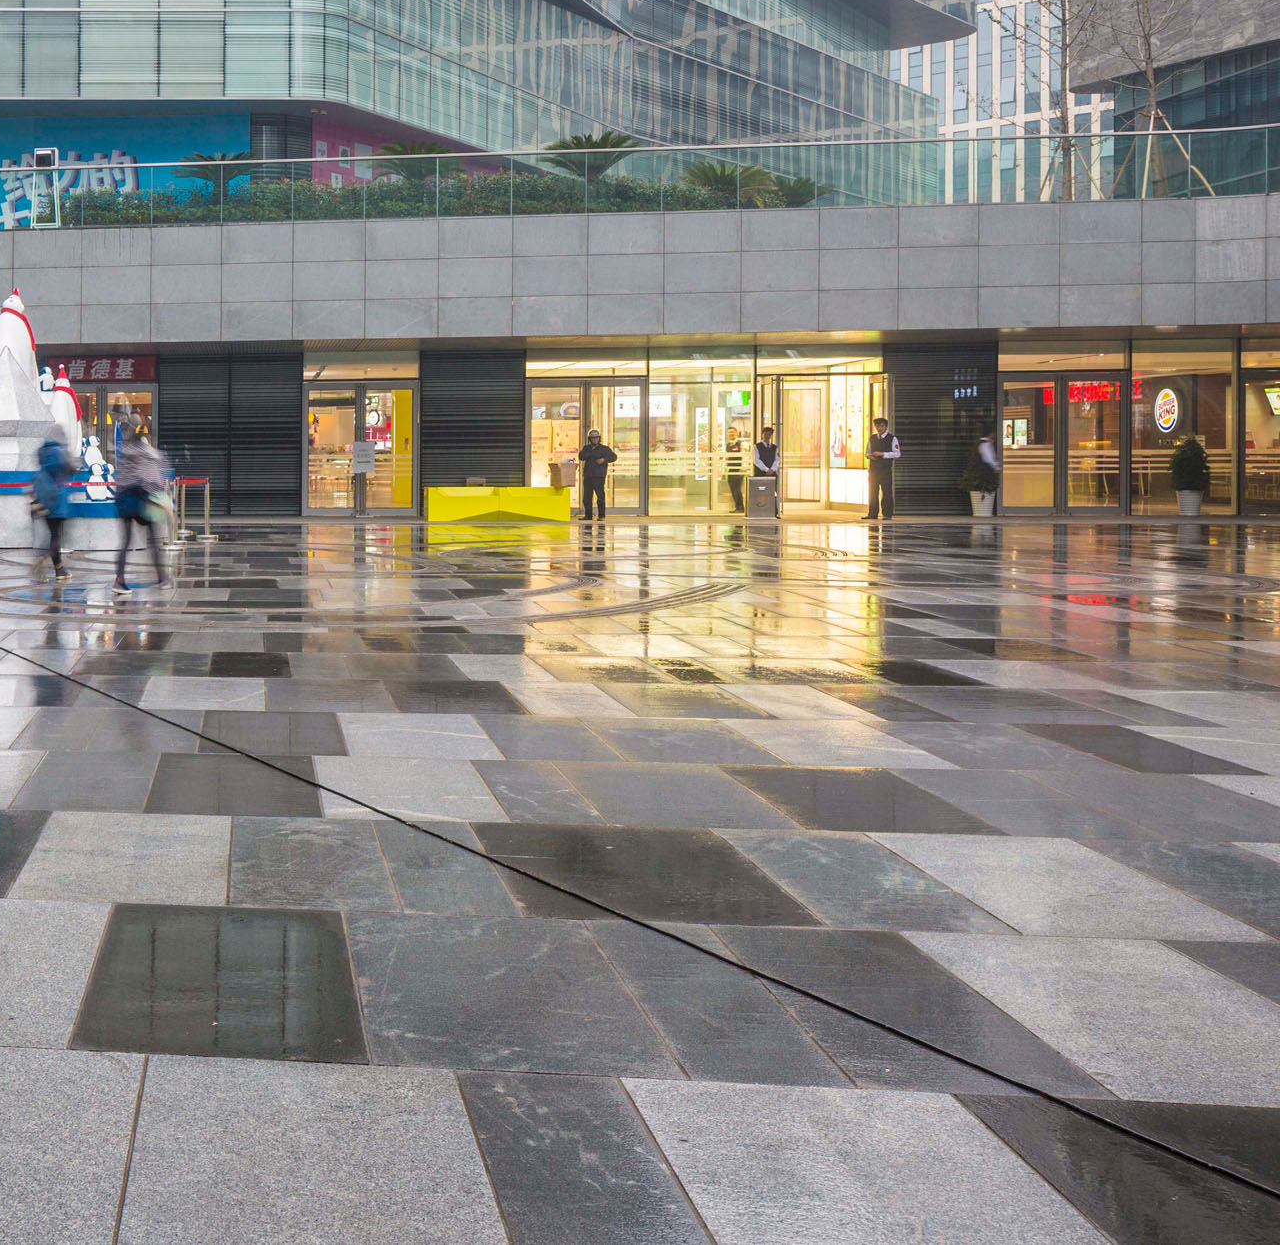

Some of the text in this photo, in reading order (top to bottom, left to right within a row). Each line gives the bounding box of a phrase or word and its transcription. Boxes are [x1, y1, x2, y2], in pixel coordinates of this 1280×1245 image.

[68, 358, 135, 380] 肯德基
[1083, 383, 1110, 402] KING
[1158, 397, 1175, 411] BURGER
[1158, 404, 1176, 421] KING
